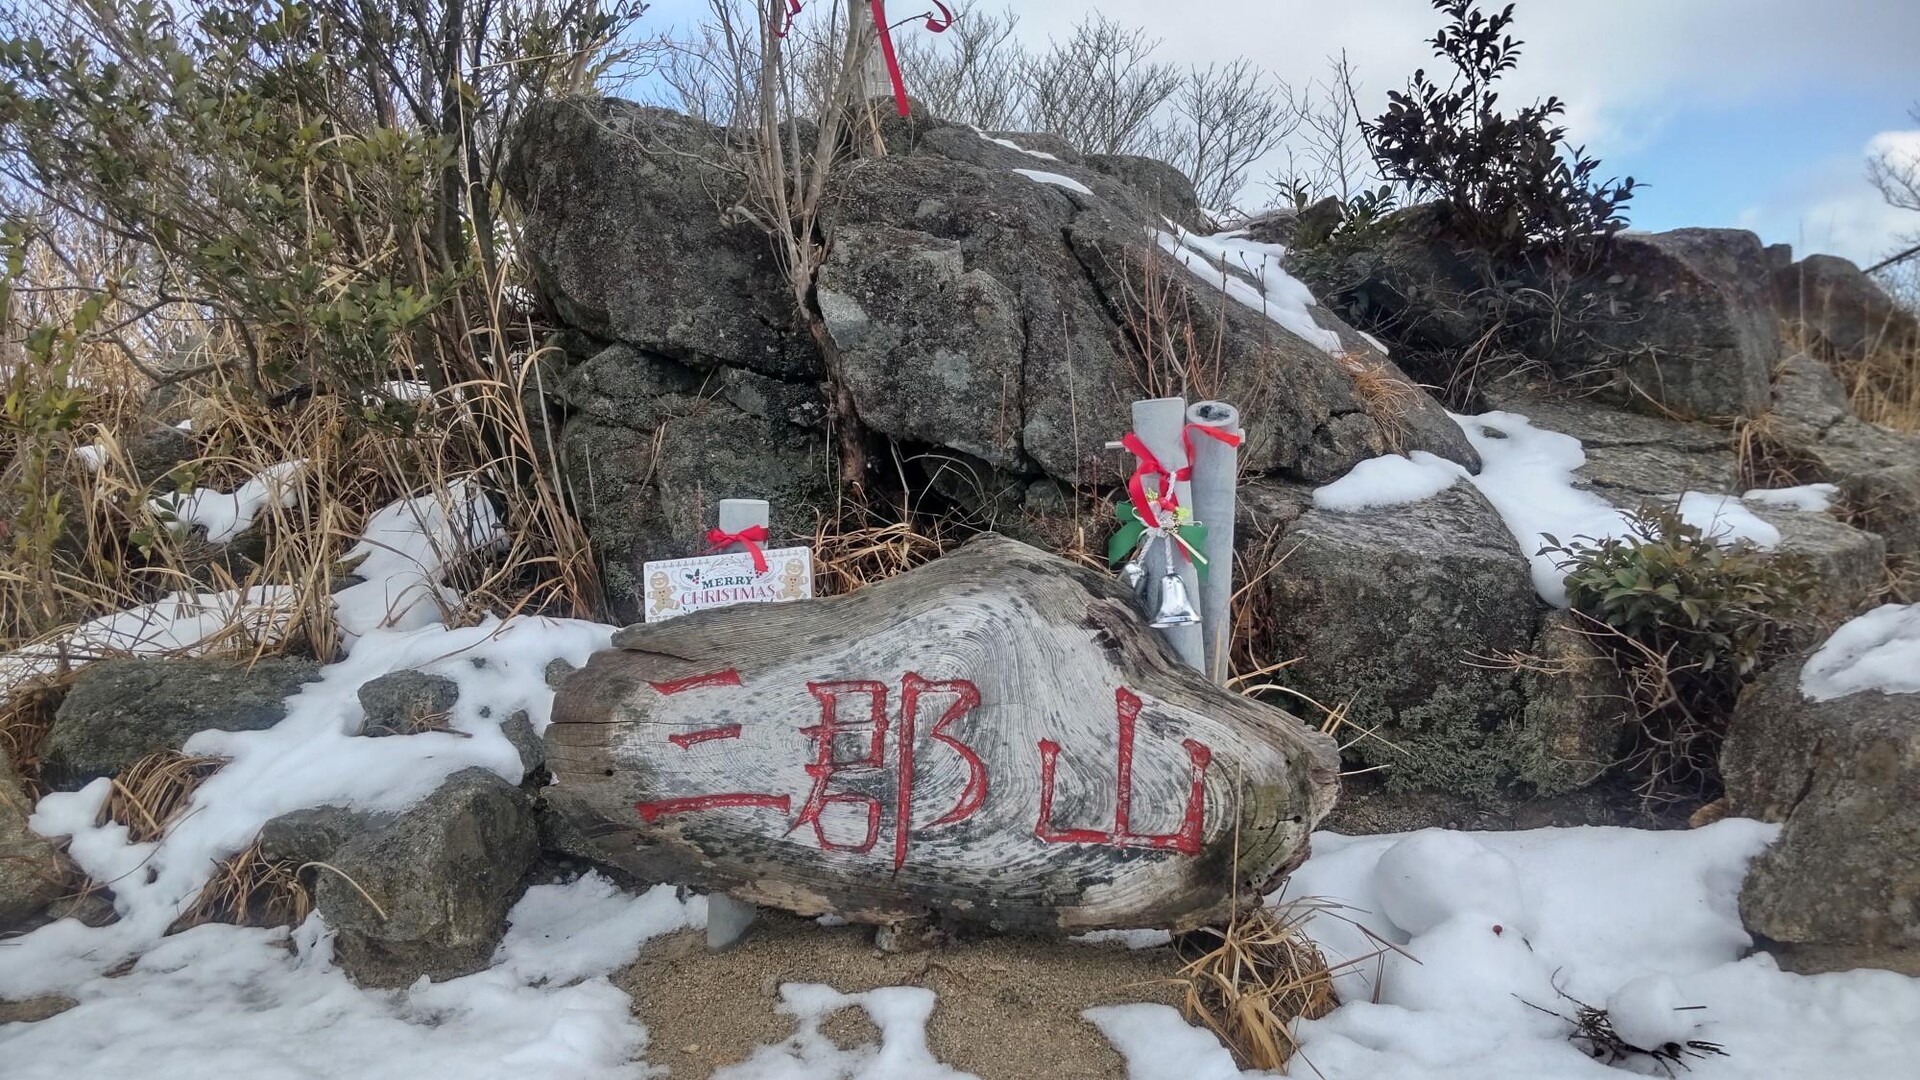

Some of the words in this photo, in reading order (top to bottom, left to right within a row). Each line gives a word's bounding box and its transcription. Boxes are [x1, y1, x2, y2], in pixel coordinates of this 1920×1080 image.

[701, 576, 754, 589] MERRY
[682, 585, 775, 606] CHRISTMAS
[640, 668, 1210, 873] 三郡山
